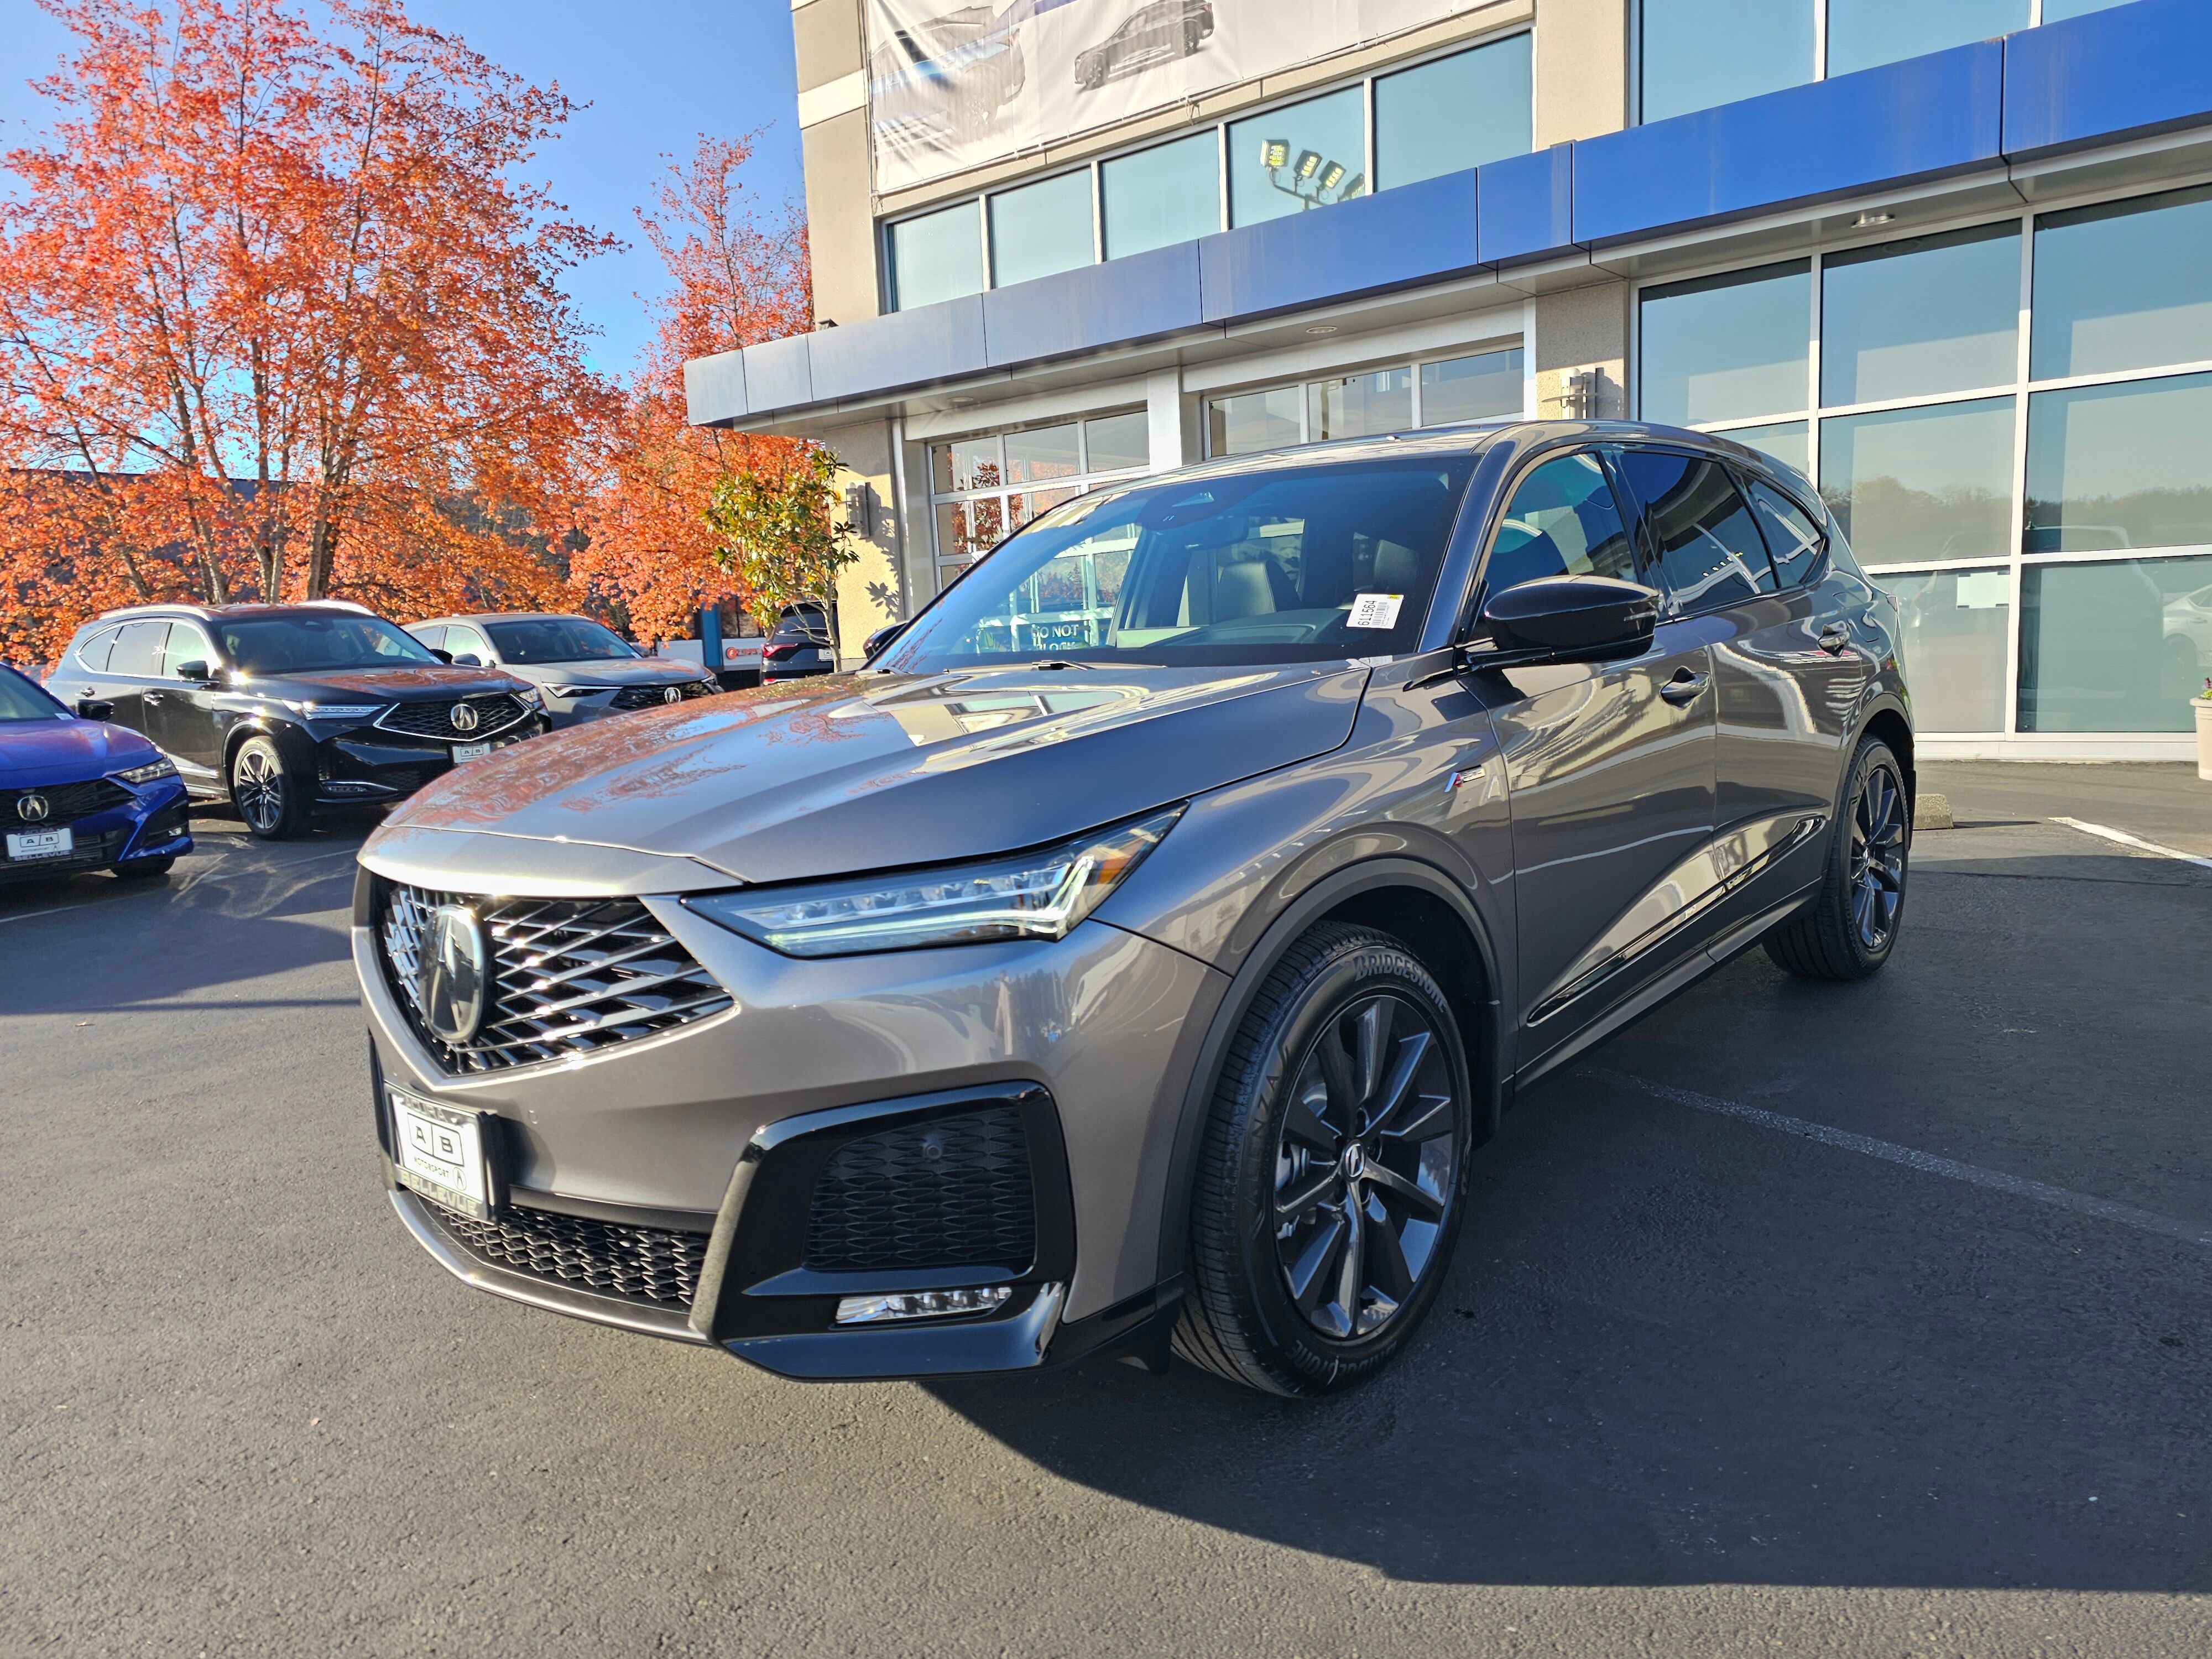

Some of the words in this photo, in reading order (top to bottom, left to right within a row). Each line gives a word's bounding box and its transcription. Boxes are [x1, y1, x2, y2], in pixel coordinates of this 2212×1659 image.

[1358, 601, 1377, 626] 611564
[1030, 627, 1050, 639] DO
[1052, 624, 1079, 637] NOT
[14, 849, 71, 862] BELLEVUE
[1353, 954, 1446, 1013] BRIDGESTONE
[403, 1095, 448, 1123] ACURA
[414, 1156, 450, 1177] MOTORSPORT
[401, 1172, 478, 1214] BELLEVUE
